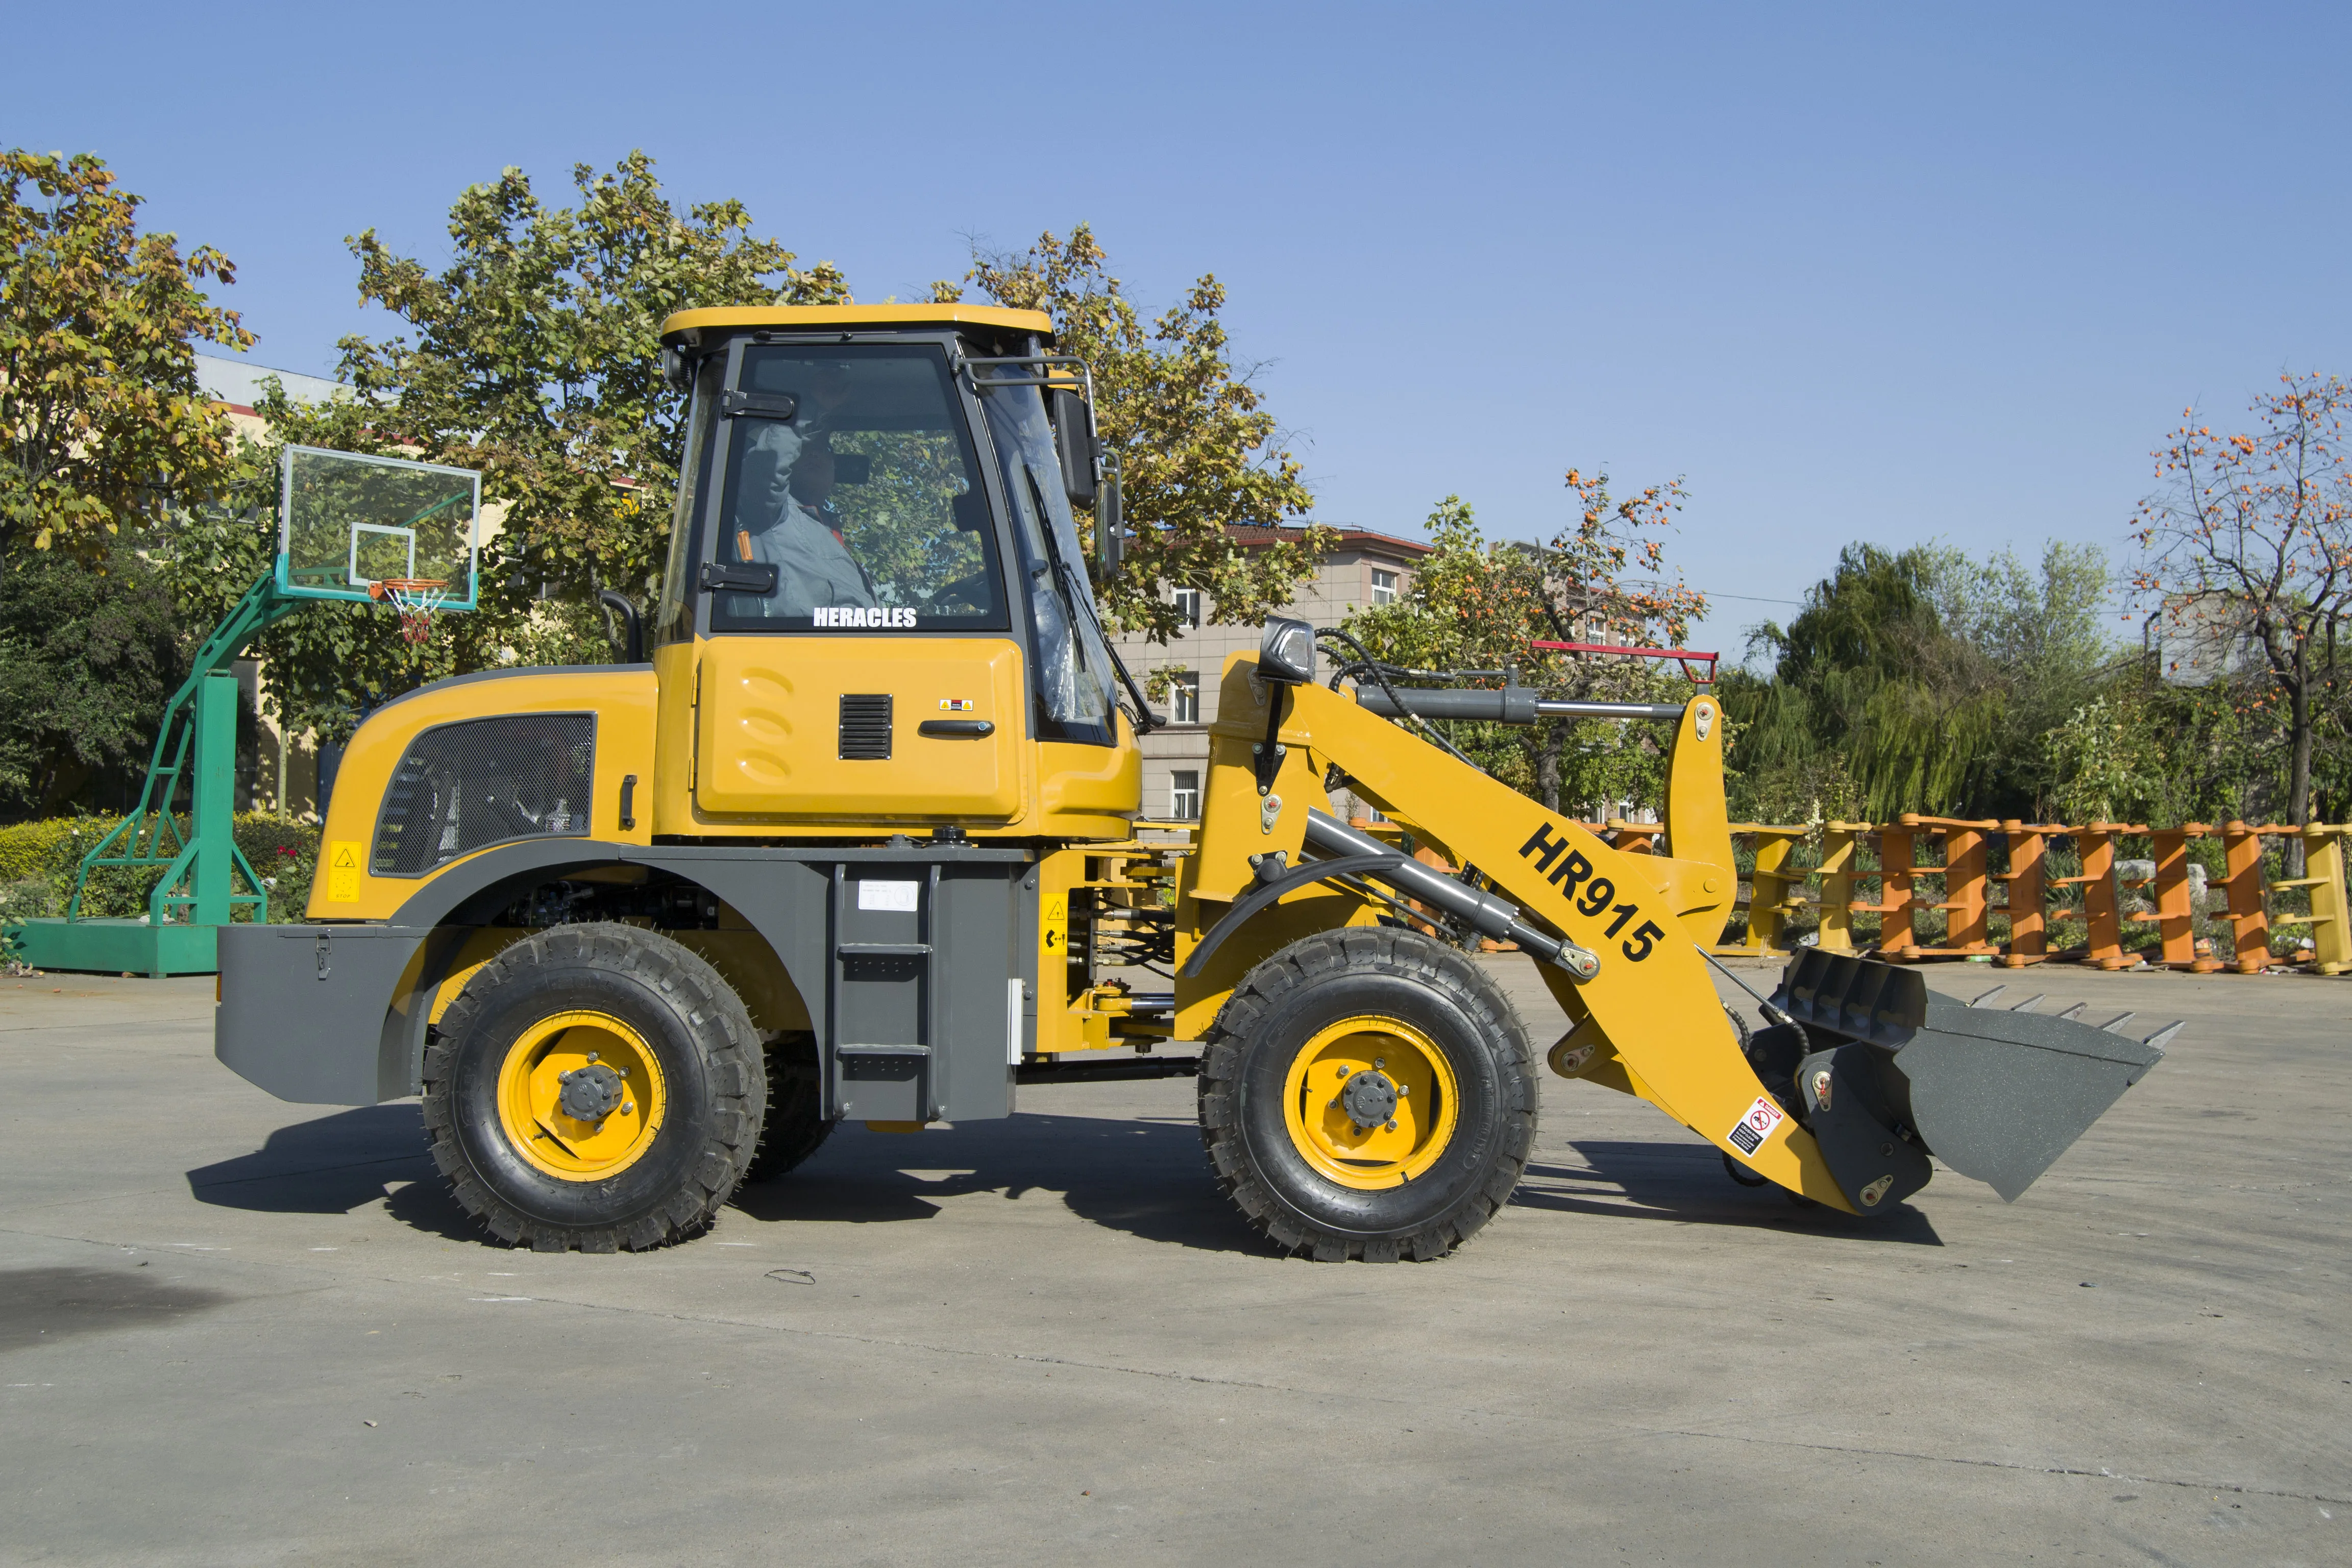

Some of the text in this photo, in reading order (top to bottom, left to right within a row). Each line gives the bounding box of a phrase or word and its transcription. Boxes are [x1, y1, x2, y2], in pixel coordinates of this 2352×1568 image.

[813, 607, 917, 628] HERACLES
[1518, 821, 1666, 963] HR915
[1765, 1105, 1779, 1117] DANGER
[1741, 1124, 1759, 1141] CRUSH RISK
[1745, 1134, 1754, 1142] CLEAR
